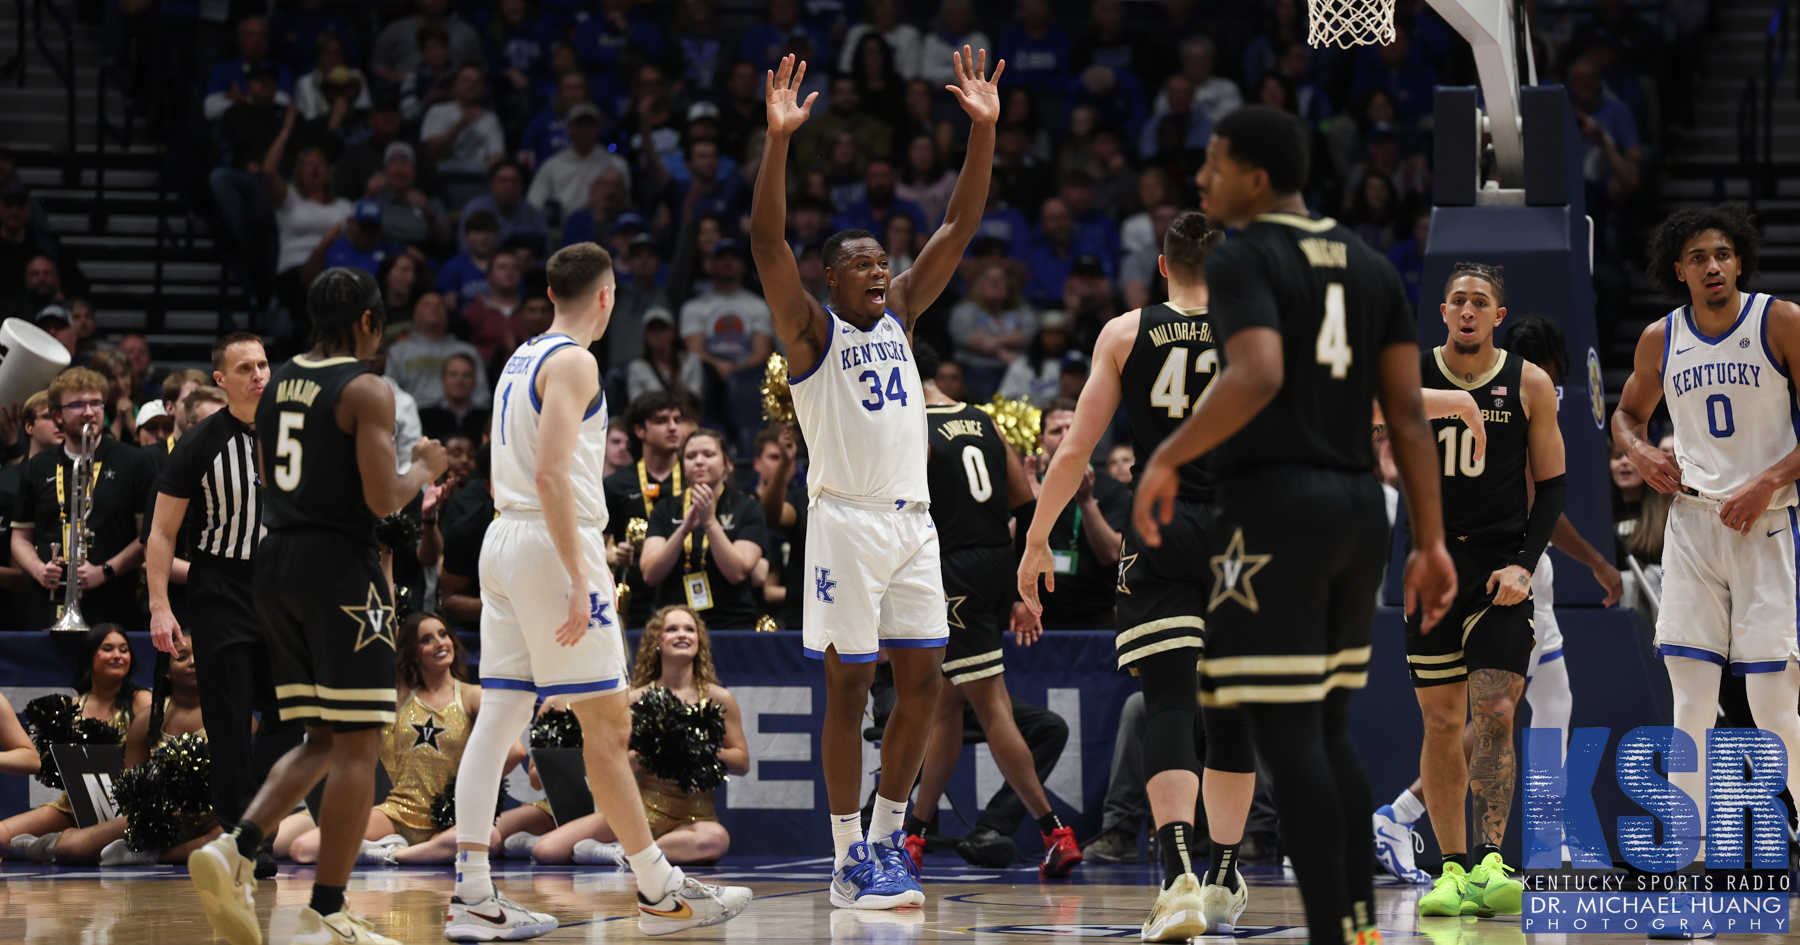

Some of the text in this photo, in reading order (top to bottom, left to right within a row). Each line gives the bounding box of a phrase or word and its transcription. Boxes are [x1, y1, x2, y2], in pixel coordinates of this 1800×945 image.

[1316, 282, 1352, 379] 4
[859, 367, 908, 411] 34
[1150, 346, 1220, 418] 42
[1672, 362, 1761, 398] KENTUCKY
[500, 382, 512, 445] 1
[937, 419, 984, 441] LAWRENCE
[1706, 393, 1735, 438] 0
[274, 411, 305, 492] 5
[962, 444, 993, 503] 0
[1437, 425, 1487, 478] 10
[366, 609, 384, 633] V
